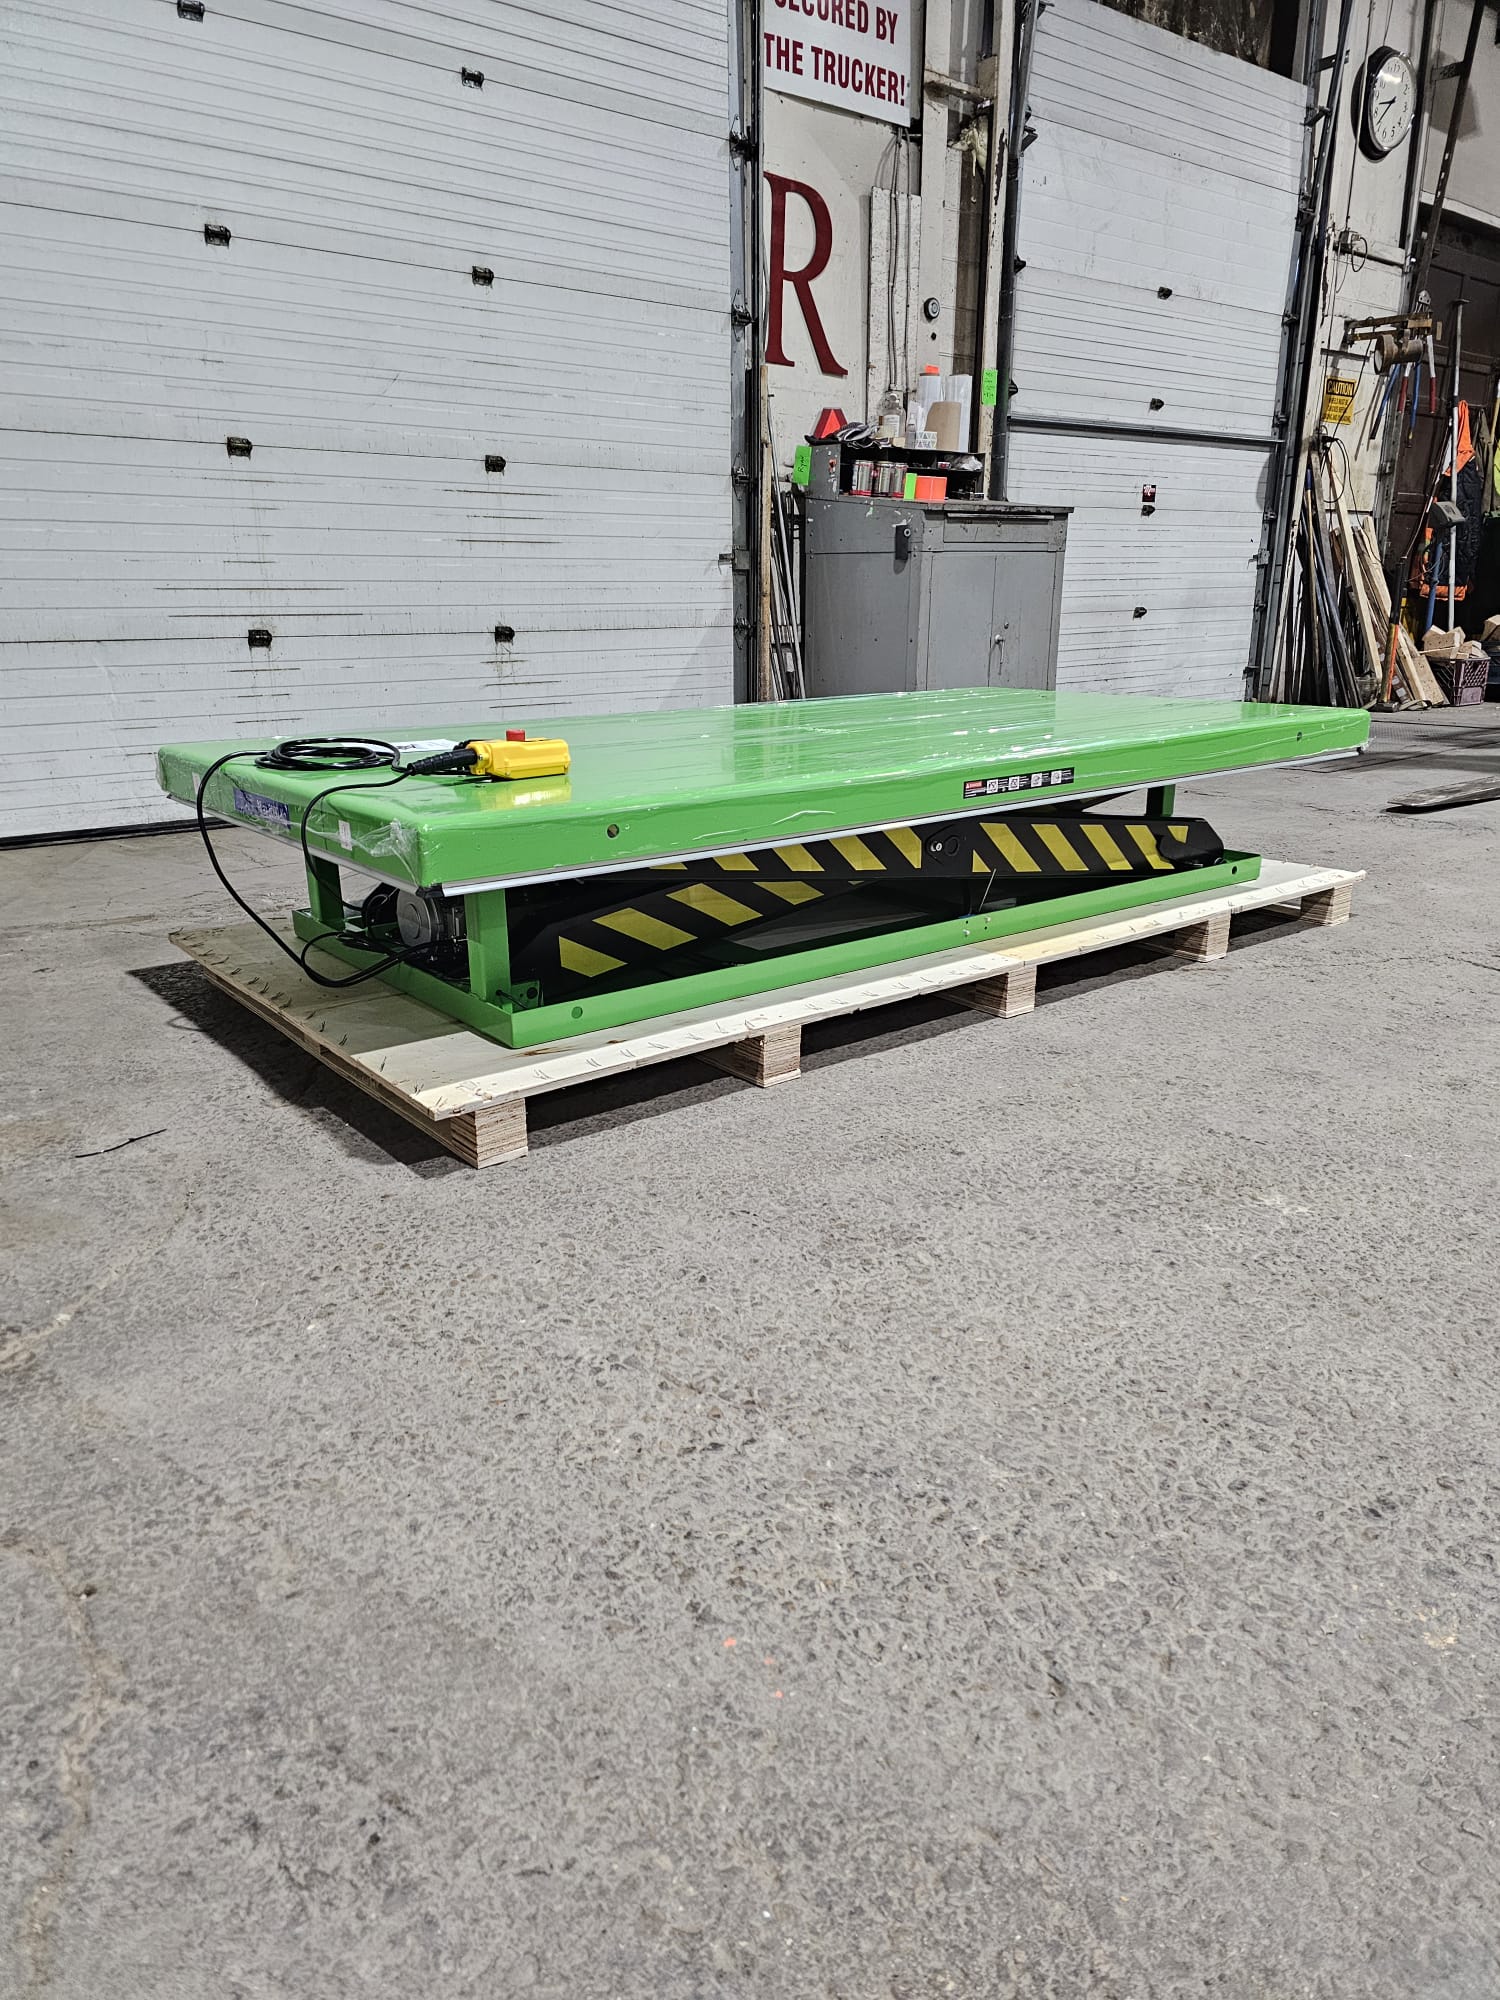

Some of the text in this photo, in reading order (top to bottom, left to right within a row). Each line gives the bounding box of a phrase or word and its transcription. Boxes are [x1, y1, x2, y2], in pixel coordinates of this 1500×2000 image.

[774, 0, 899, 45] URED BY
[763, 32, 905, 107] THE TRUCKER!
[763, 171, 849, 376] R
[1327, 380, 1355, 396] CAUTION
